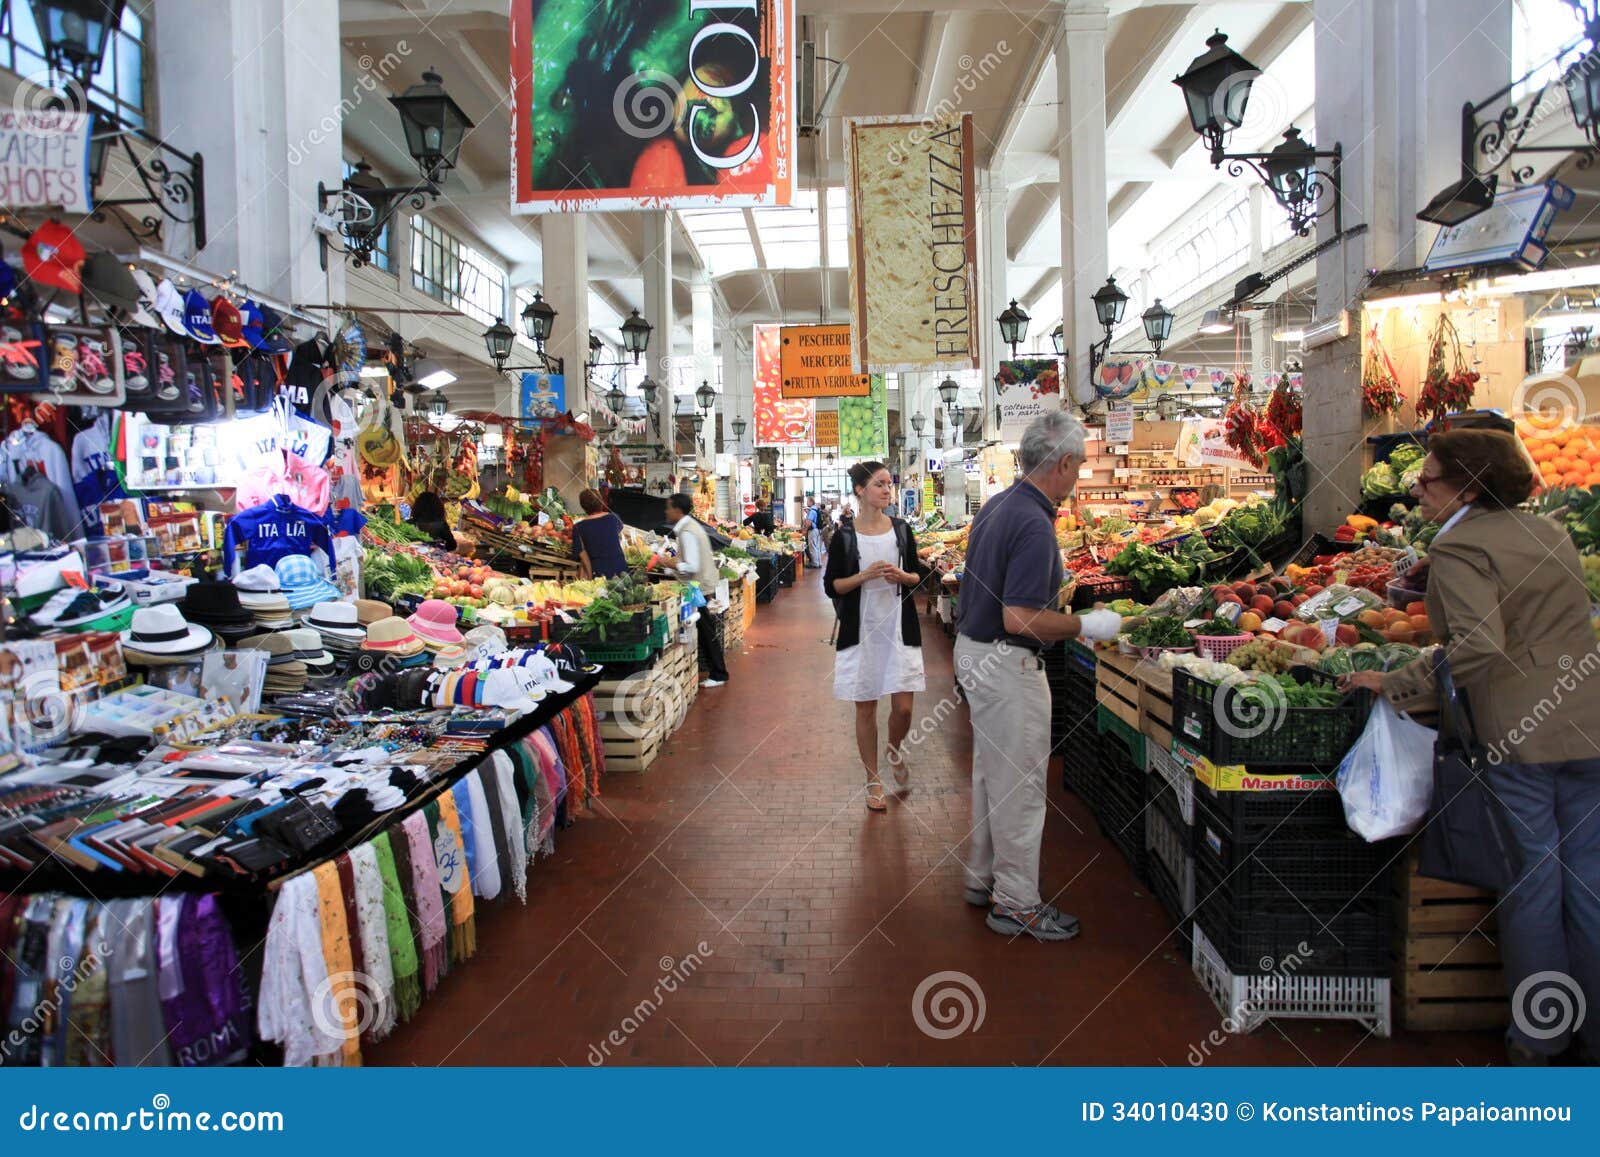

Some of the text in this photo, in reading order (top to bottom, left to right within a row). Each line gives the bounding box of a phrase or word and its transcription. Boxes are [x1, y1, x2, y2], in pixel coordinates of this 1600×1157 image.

[928, 125, 969, 357] FRESCHEZZA
[798, 333, 851, 346] PESCHERIE
[800, 354, 851, 368] MERCERIE
[791, 375, 860, 389] FRUTTA VERDURA
[1241, 776, 1338, 790] Mantion
